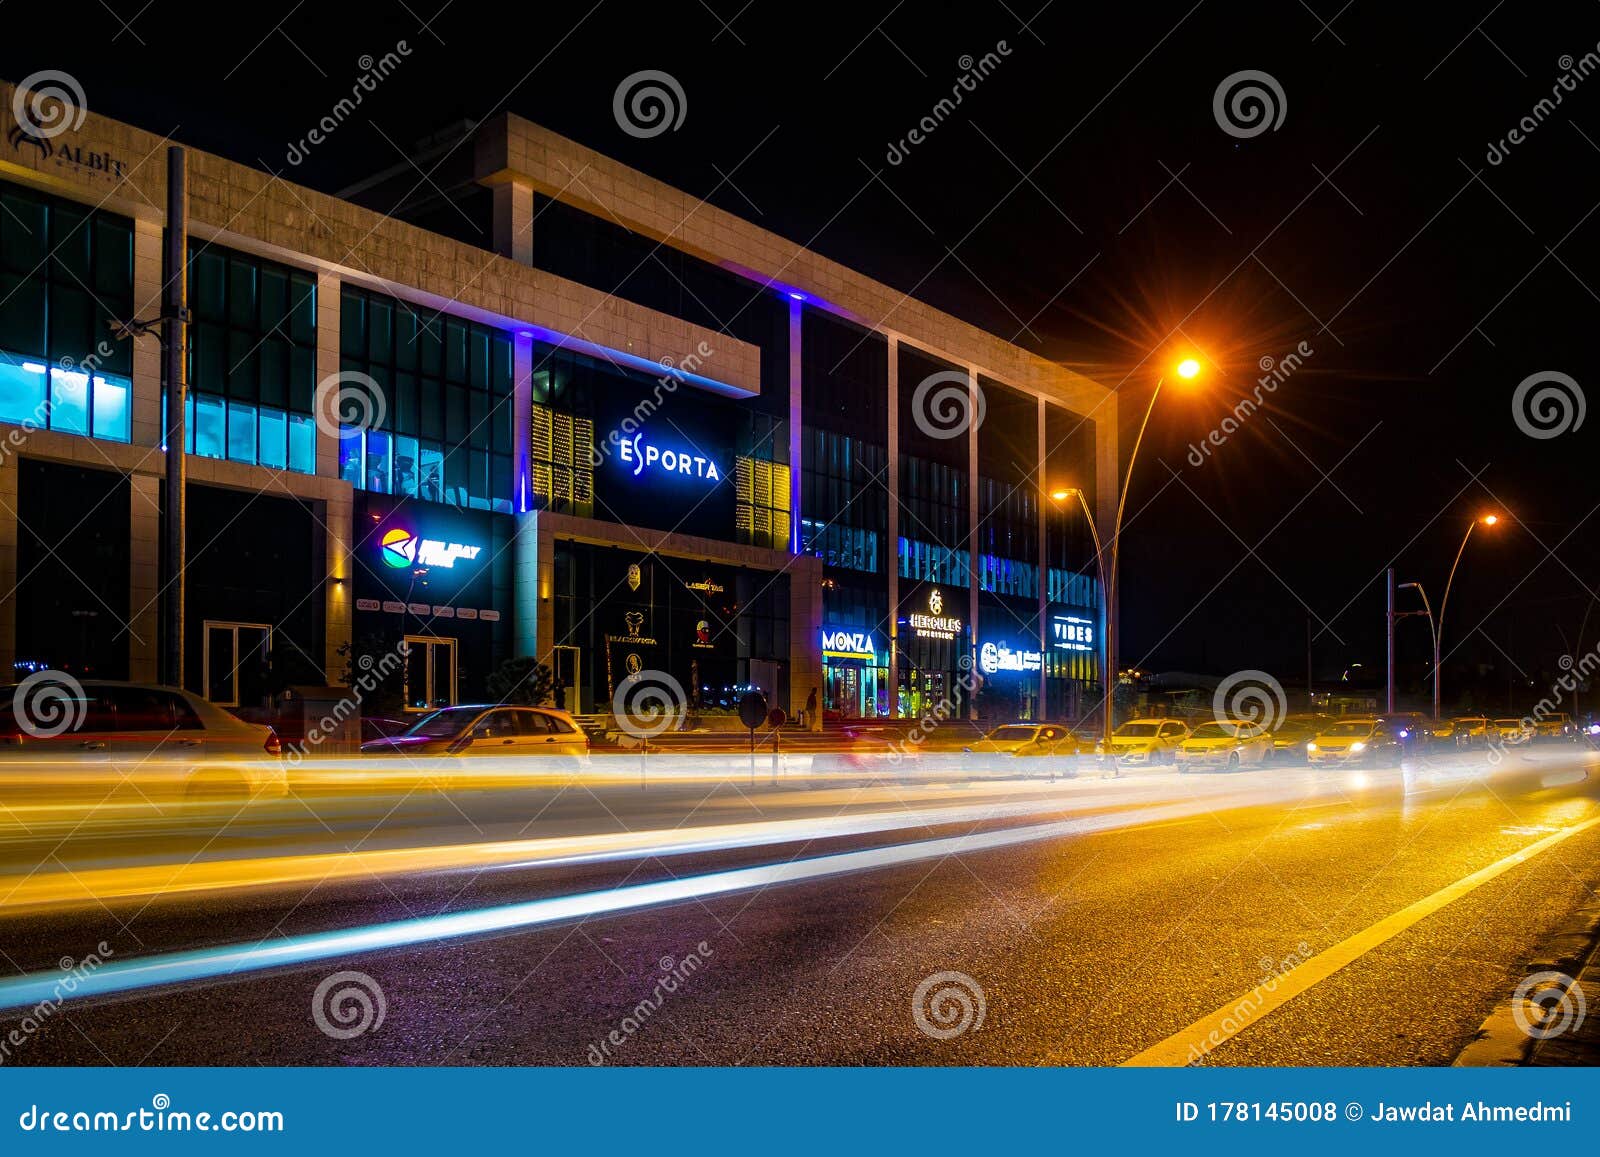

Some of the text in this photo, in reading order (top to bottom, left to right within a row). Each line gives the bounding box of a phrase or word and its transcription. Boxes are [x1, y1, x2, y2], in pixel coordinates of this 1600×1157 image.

[621, 433, 719, 480] ESPORTA
[909, 614, 962, 632] HERCULES
[1054, 623, 1093, 643] VIBES
[822, 631, 874, 653] MONZA
